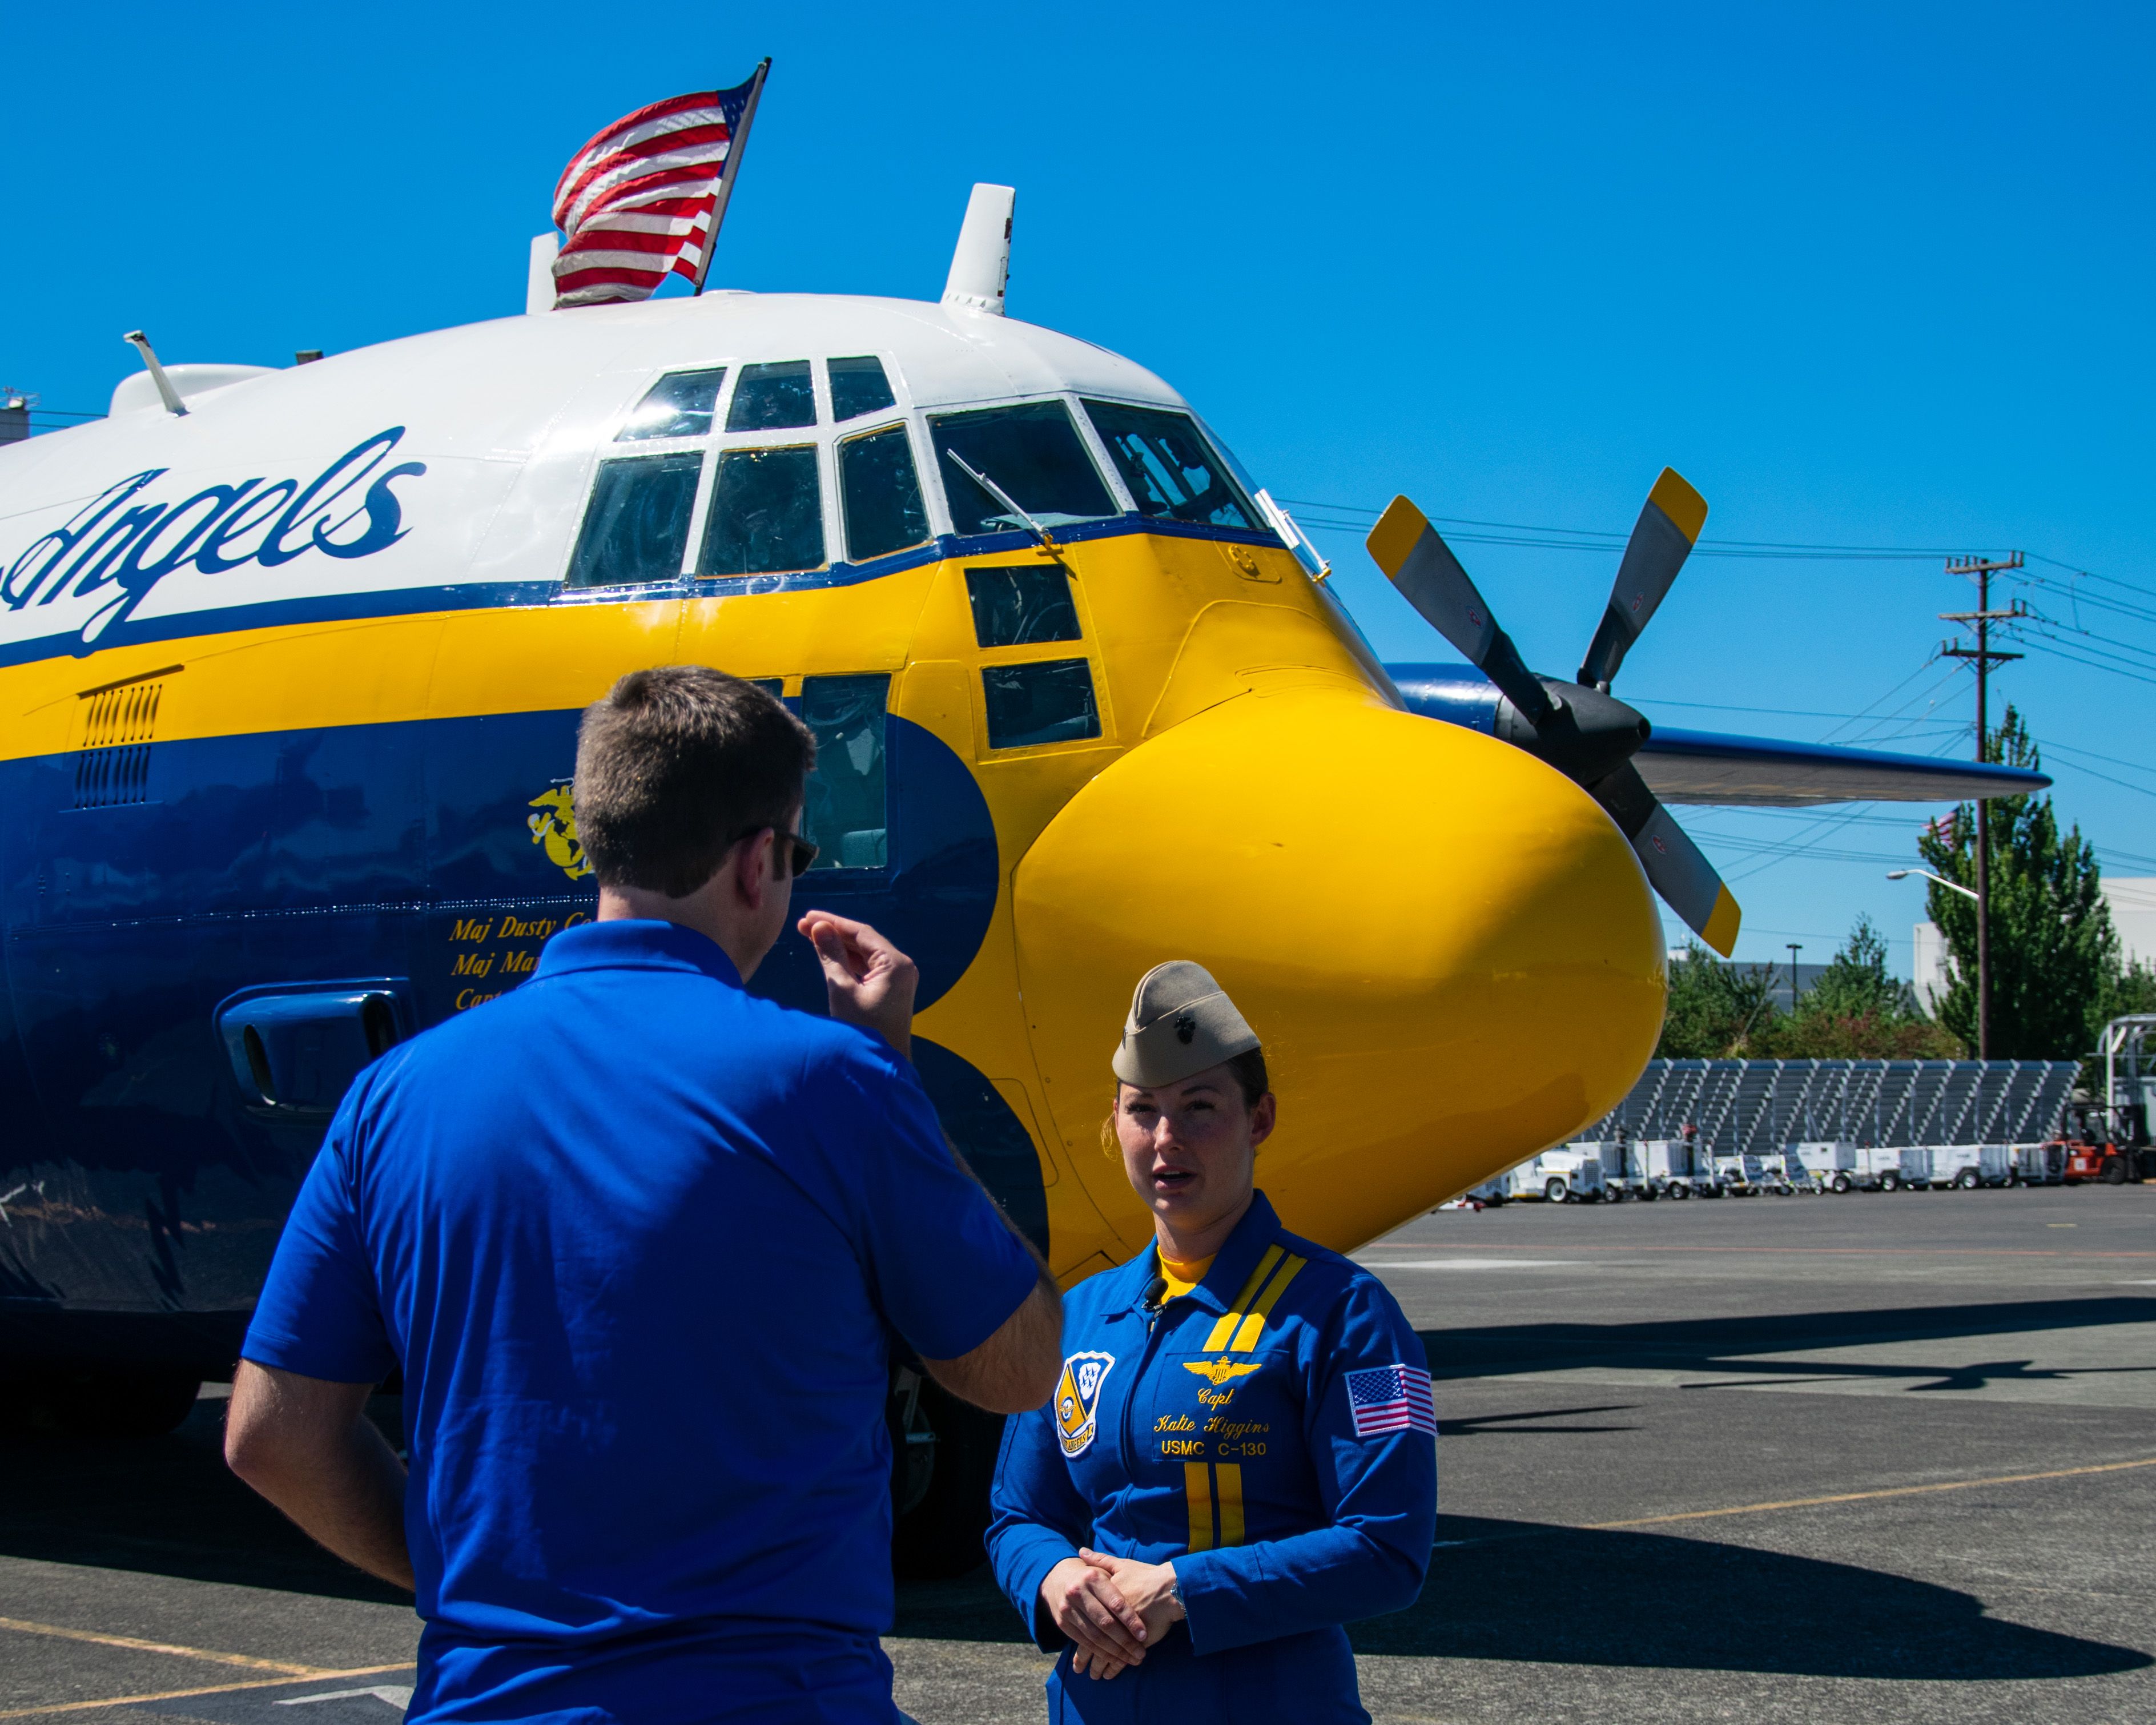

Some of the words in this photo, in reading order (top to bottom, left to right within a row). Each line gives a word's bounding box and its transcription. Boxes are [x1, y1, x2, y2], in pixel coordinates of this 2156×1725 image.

[0, 426, 427, 658] Angels
[448, 917, 493, 943] Maj
[497, 916, 557, 940] Dusty
[450, 952, 496, 978] Maj
[1197, 1388, 1235, 1411] Capt
[1153, 1414, 1197, 1432] Katie
[1204, 1416, 1270, 1439] Higgins
[1161, 1440, 1205, 1455] USMC
[1217, 1442, 1267, 1456] C-130
